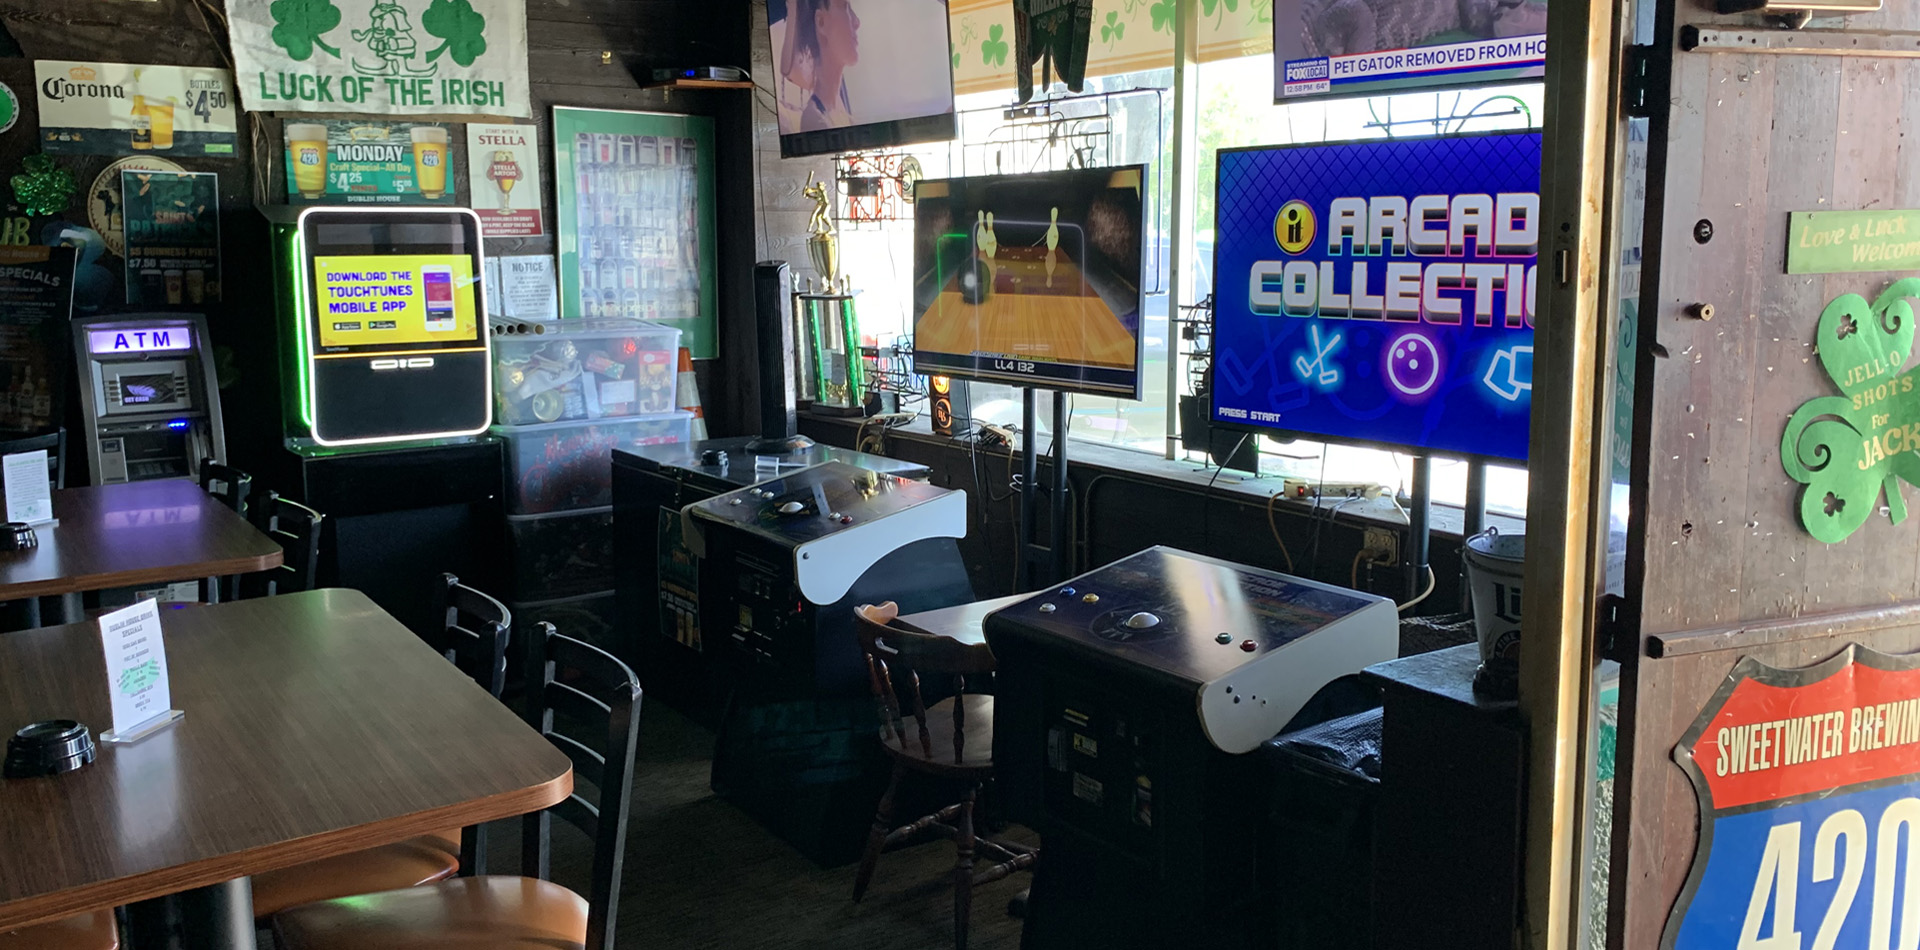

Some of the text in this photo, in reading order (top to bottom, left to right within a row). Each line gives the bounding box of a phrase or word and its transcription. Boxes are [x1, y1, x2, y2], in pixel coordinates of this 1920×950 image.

[1287, 61, 1317, 69] STREAMING
[1334, 60, 1356, 74] PET
[1358, 55, 1403, 72] GATOR
[1406, 46, 1476, 67] REMOVED
[1479, 42, 1521, 59] FROM
[1287, 65, 1328, 81] FOX LOCAL
[42, 77, 125, 103] Corona
[190, 79, 222, 90] BOTTLES
[259, 72, 505, 107] LUCK OF THE IRISH
[478, 135, 526, 146] STELLA
[302, 153, 319, 164] 420
[337, 144, 404, 162] MONDAY
[423, 154, 438, 166] 420
[330, 163, 350, 171] Craft
[397, 163, 411, 173] Day
[1328, 192, 1540, 258] ARCAD
[1800, 215, 1908, 248] Love & Luck
[512, 262, 544, 272] NOTICE
[0, 266, 61, 287] SPECIALS
[326, 271, 412, 282] DOWNLOAD THE
[327, 285, 413, 298] TOUCHTUNES
[329, 301, 407, 313] MOBILE APP
[114, 331, 171, 349] ATM
[1844, 350, 1901, 387] JELL-O
[1852, 375, 1913, 410] SHOTS
[1218, 406, 1281, 424] PRESS START
[1871, 413, 1890, 429] For
[1715, 697, 1920, 777] SWEETWATER BREWIN
[1736, 797, 1920, 950] 420
